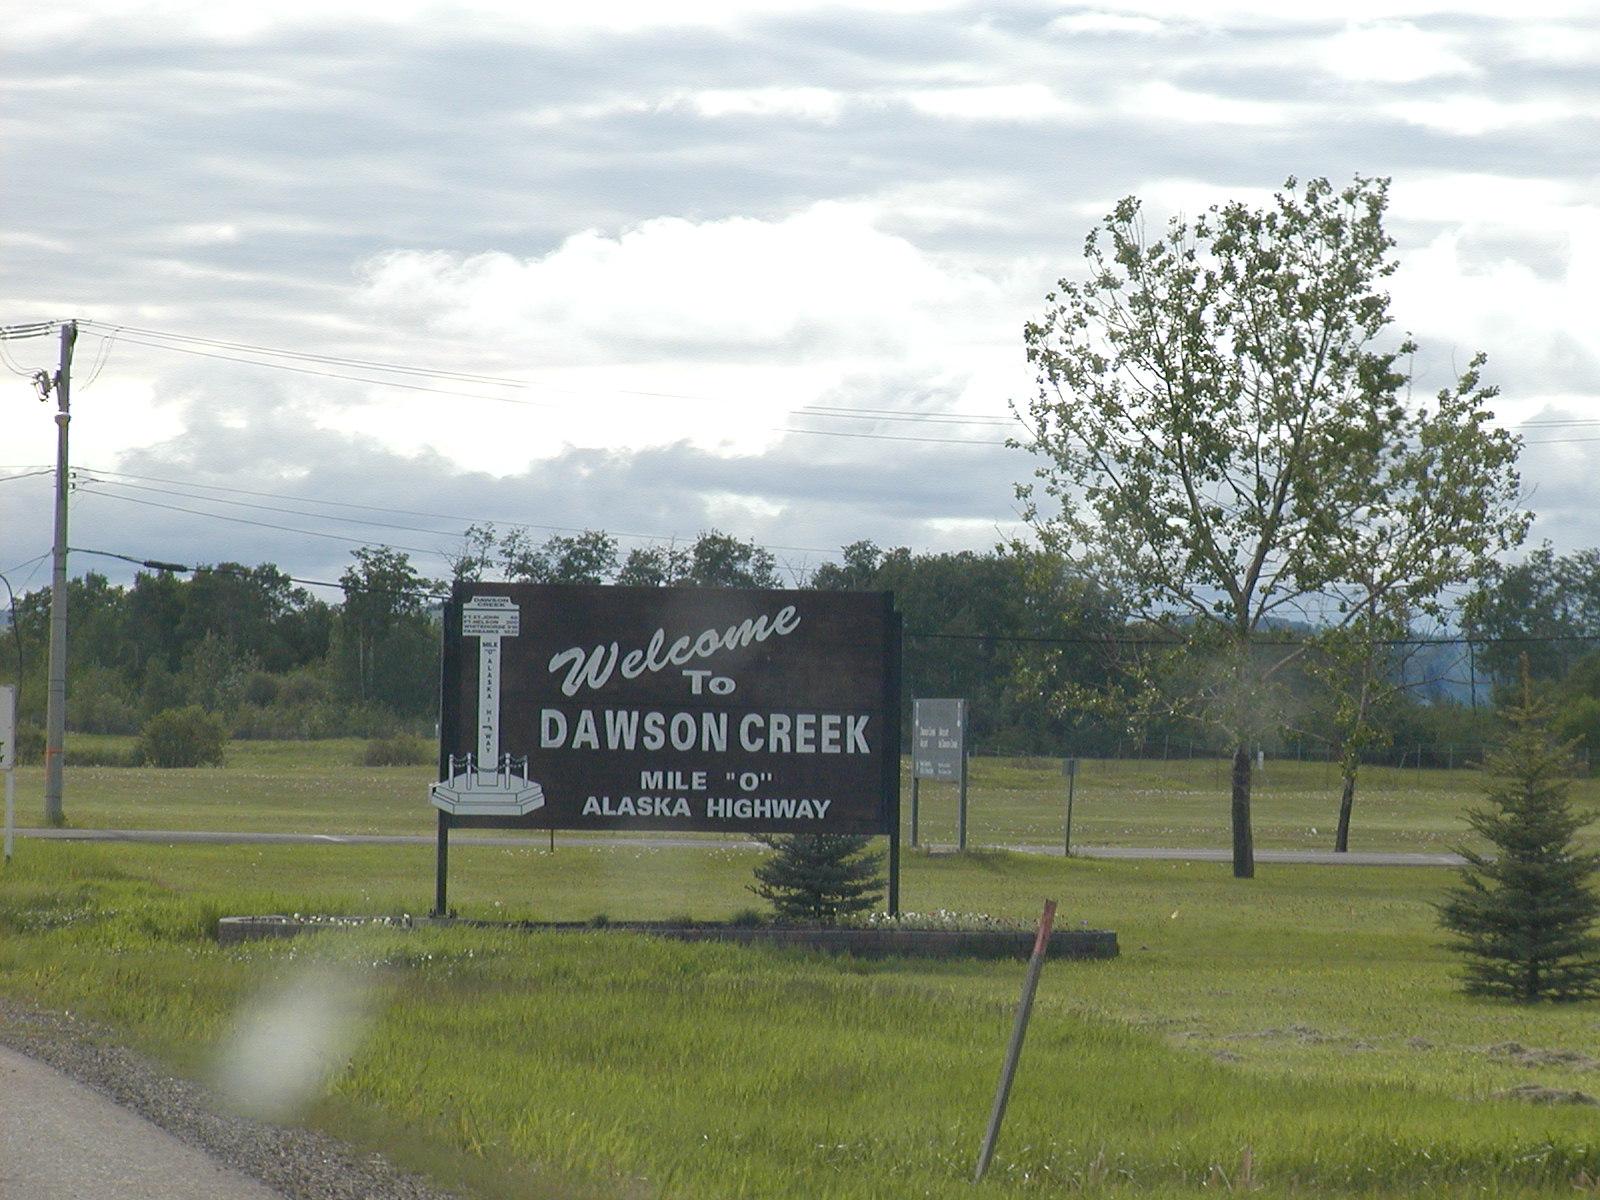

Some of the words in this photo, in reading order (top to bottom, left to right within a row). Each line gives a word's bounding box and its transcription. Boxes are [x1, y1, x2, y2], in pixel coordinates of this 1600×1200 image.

[548, 605, 801, 697] Welcome
[682, 670, 736, 695] To
[540, 708, 728, 751] DAWSON
[739, 713, 871, 754] CREEK
[640, 770, 707, 791] MILE
[582, 796, 692, 817] ALASKA
[706, 798, 832, 819] HIGHWAY
